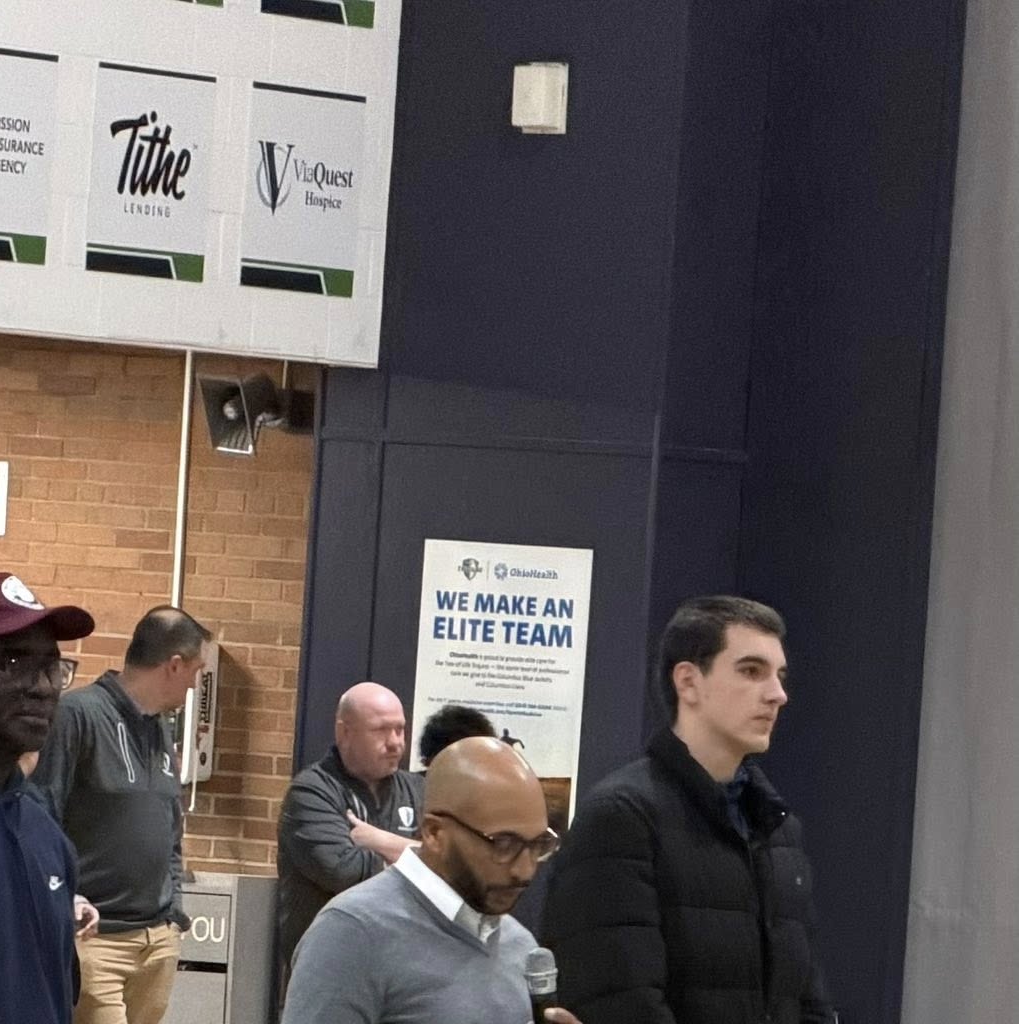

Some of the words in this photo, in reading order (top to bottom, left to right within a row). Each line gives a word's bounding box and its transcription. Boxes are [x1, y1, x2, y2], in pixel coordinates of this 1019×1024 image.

[110, 110, 191, 200] Tithe
[293, 158, 354, 191] ViaQuest
[123, 202, 171, 218] LENDING
[305, 190, 342, 212] Hospice
[436, 590, 470, 612] WE
[473, 593, 538, 617] MAKE
[542, 597, 575, 619] AN
[432, 616, 496, 643] ELITE
[502, 621, 574, 648] TEAM
[181, 916, 225, 943] OU
